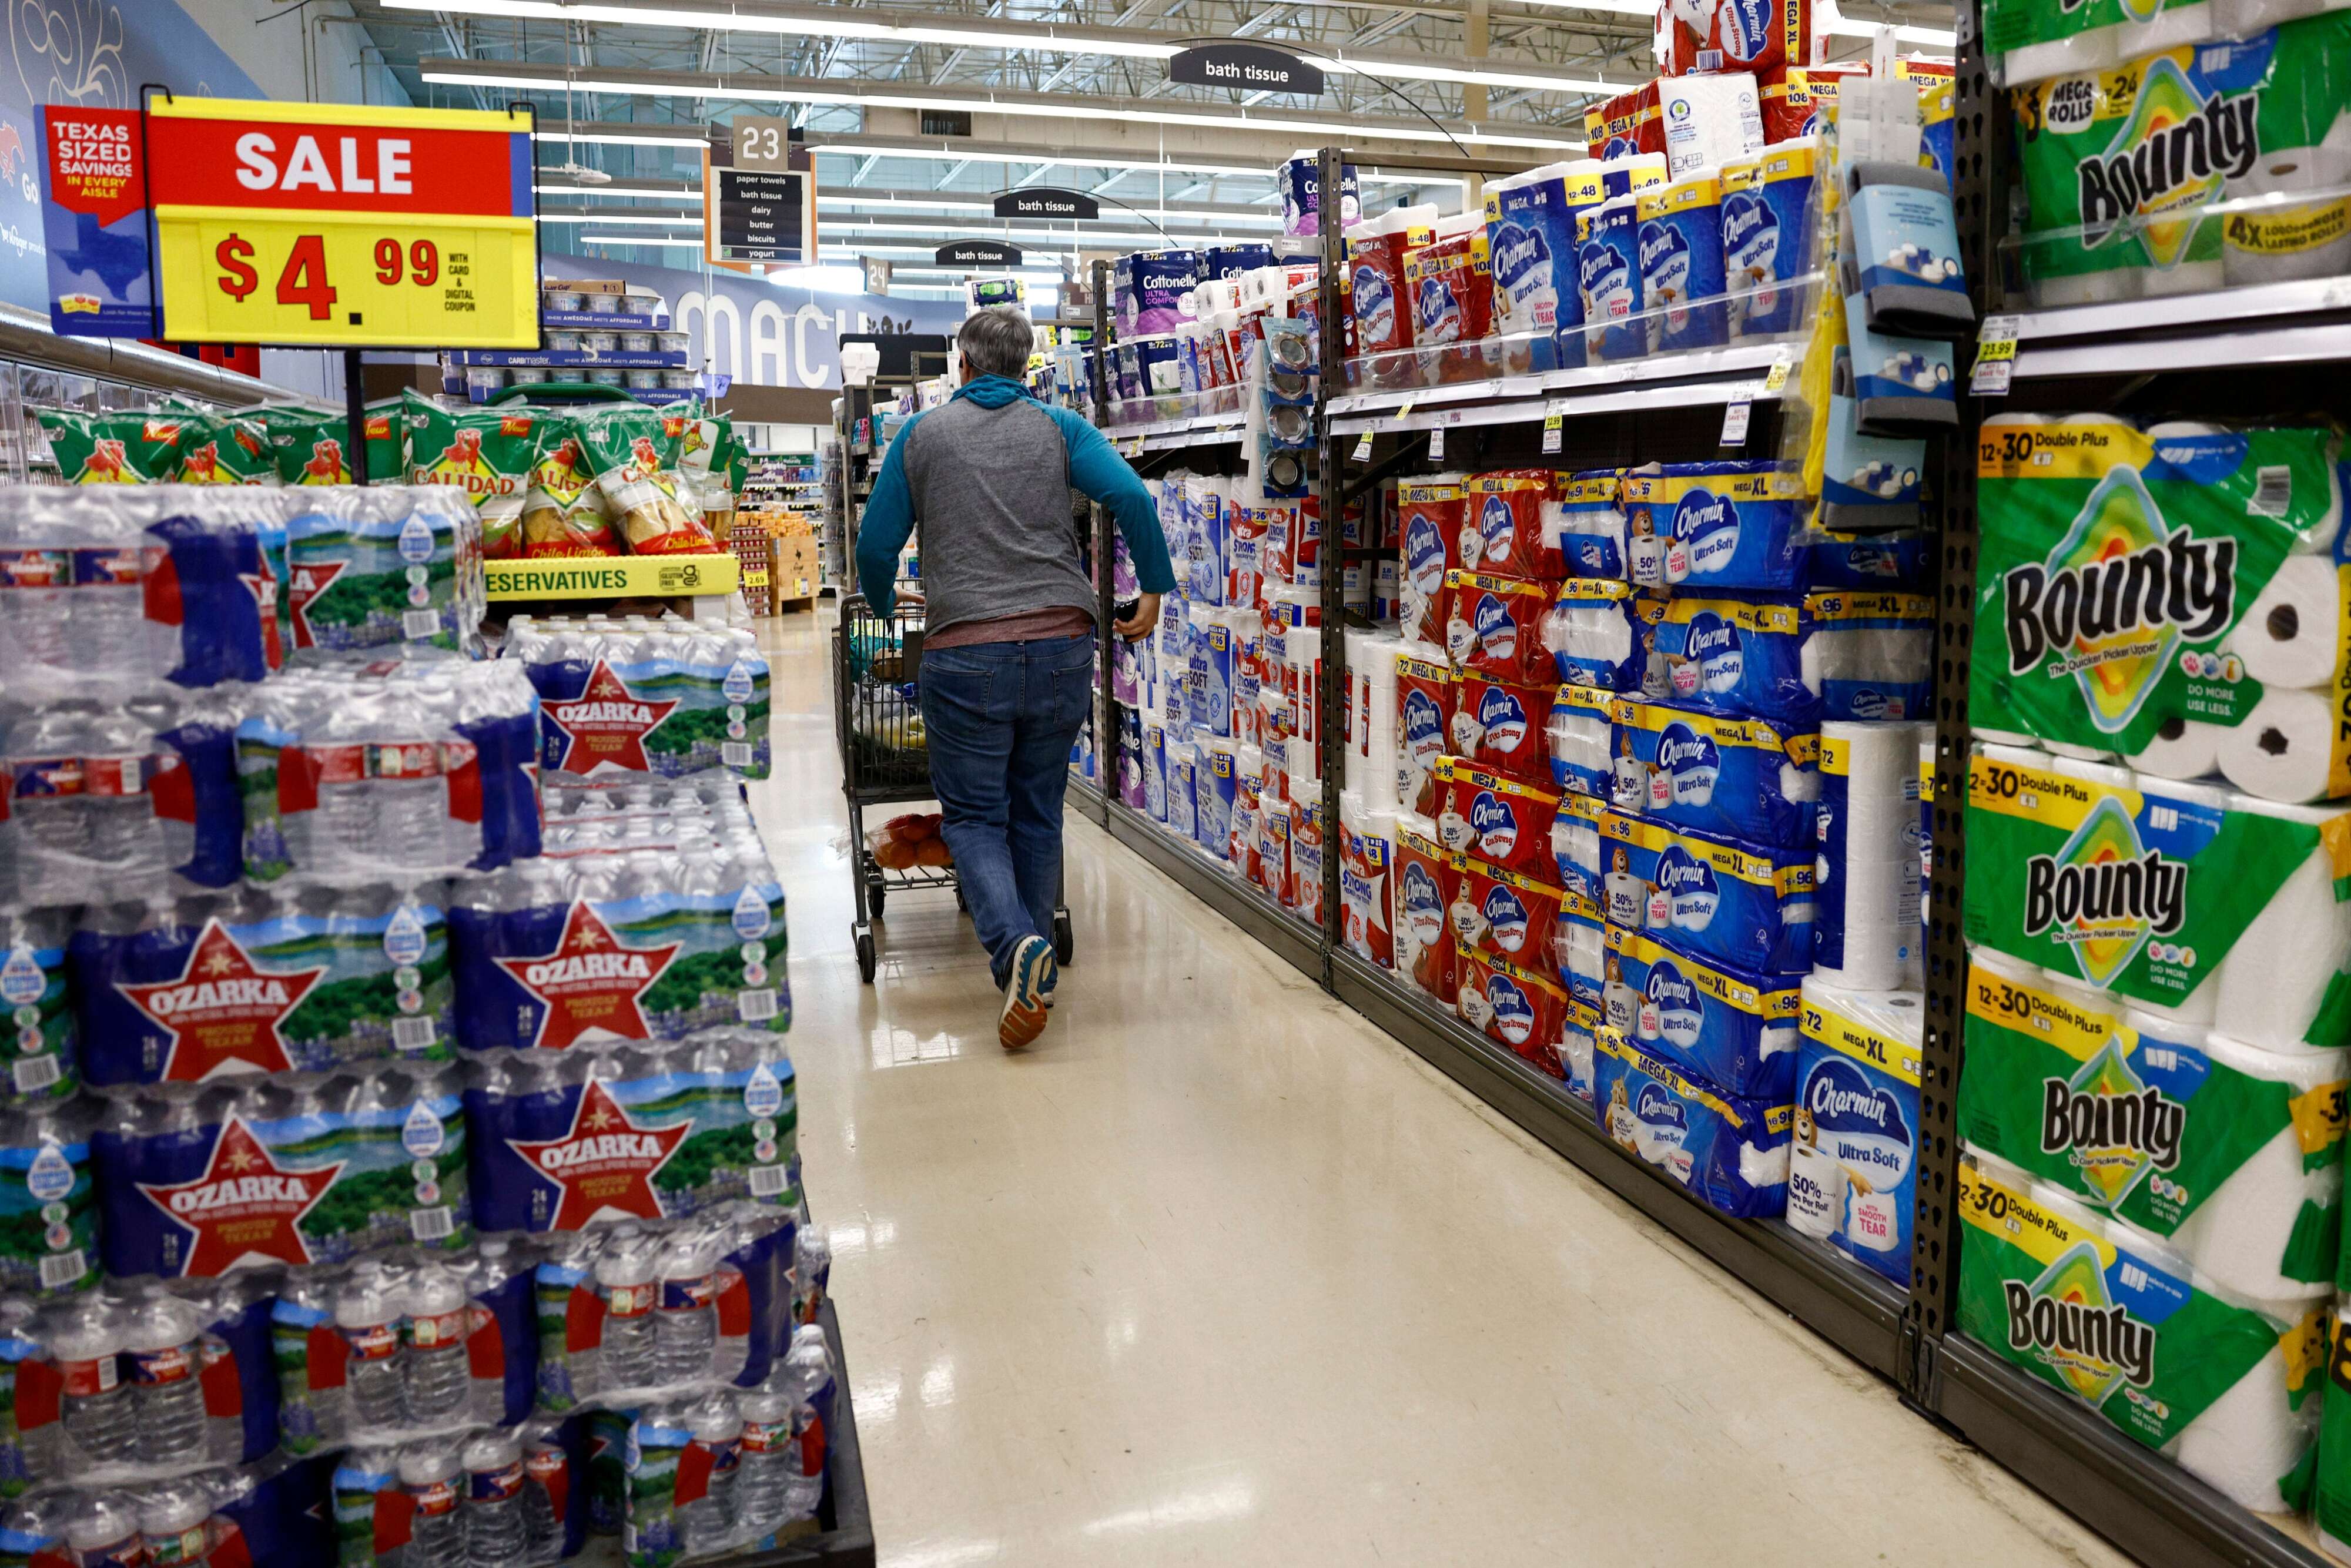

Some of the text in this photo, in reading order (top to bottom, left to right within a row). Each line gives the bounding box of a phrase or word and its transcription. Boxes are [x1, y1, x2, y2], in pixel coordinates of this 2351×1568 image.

[1205, 61, 1289, 82] bath tissue
[1788, 92, 1808, 103] 108
[1810, 85, 1837, 96] MEGA
[2052, 80, 2092, 103] MEGA
[2049, 100, 2093, 122] ROLLS
[52, 122, 129, 142] TEXAS
[58, 140, 131, 162] SIZED
[743, 126, 779, 160] 23
[60, 160, 132, 177] SAVINGS
[236, 132, 413, 195] SALE
[2081, 95, 2256, 247] Bounty
[68, 176, 127, 187] IN EVERY
[760, 176, 786, 185] towels
[81, 188, 118, 198] AISLE
[761, 192, 782, 200] tissue
[751, 206, 771, 215] dairy
[1018, 200, 1075, 212] bath tissue
[749, 220, 773, 229] butter
[1723, 205, 1763, 246] Charmin
[747, 234, 775, 243] biscuits
[448, 253, 468, 263] WITH
[749, 250, 775, 258] yogurt
[955, 251, 1003, 261] bath tissue
[1495, 236, 1538, 281] Charmin
[1639, 230, 1674, 270] Charmin
[448, 266, 469, 276] CARD
[1422, 260, 1441, 274] MEGA
[1581, 249, 1612, 286] Charmin
[456, 277, 462, 287] &
[869, 266, 885, 287] 24
[1143, 273, 1197, 290] Cottonelle
[445, 290, 474, 300] DIGITAL
[1515, 282, 1532, 304] Ultra
[444, 301, 475, 311] COUPON
[1534, 301, 1555, 311] SMOOTH
[1610, 306, 1627, 317] TEAR
[1535, 311, 1555, 324] TEAR
[1547, 416, 1560, 426] 22.99
[2035, 432, 2077, 447] Double
[2081, 431, 2108, 447] Plus
[414, 470, 514, 494] CALIDAD
[1752, 478, 1768, 496] XL
[1676, 500, 1724, 538] Charmin
[1407, 530, 1435, 561] Charmin
[1694, 537, 1734, 562] Ultra Soft
[1670, 562, 1686, 574] TEAR
[1878, 597, 1901, 613] XL
[2008, 529, 2234, 671] Bounty
[1164, 605, 1178, 617] ultra
[1478, 604, 1504, 631] Charmin
[1163, 618, 1179, 631] SOFT
[1268, 623, 1280, 634] ultra
[1265, 636, 1285, 651] STRONG
[1189, 656, 1207, 670] ultra
[2068, 642, 2159, 671] Quicker Picker Upper
[1189, 672, 1208, 688] SOFT
[2188, 684, 2236, 701] DO MORE.
[556, 702, 653, 723] OZARKA
[1166, 707, 1181, 721] SOFT
[2188, 700, 2232, 716] USE LESS.
[1406, 705, 1436, 732] Charmin
[1716, 727, 1739, 738] MEGA
[548, 736, 560, 747] 24
[1264, 741, 1285, 757] STRONG
[1660, 733, 1706, 766] Charmin
[1677, 778, 1696, 793] Ultra
[2021, 773, 2088, 802] Double Plus
[1298, 826, 1315, 843] ultra
[1294, 840, 1321, 861] STRONG
[1368, 848, 1378, 859] 48
[1712, 853, 1744, 874] MEGA XL
[1661, 859, 1706, 888] Charmin
[1342, 870, 1372, 900] STRONG
[1405, 876, 1434, 903] Charmin
[2027, 853, 2186, 934] Bounty
[1486, 897, 1518, 917] Charmin
[1615, 893, 1633, 906] 50%
[1677, 902, 1712, 915] Ultra Soft
[2094, 930, 2115, 939] Picker
[527, 954, 649, 985] OZARKA
[1649, 973, 1691, 1004] Charmin
[1697, 973, 1729, 999] MEGA XL
[149, 979, 290, 1016] OZARKA
[1489, 990, 1520, 1009] Charmin
[1663, 1018, 1682, 1030] Ultra
[2032, 997, 2073, 1024] Double
[2074, 1016, 2103, 1035] Plus
[1843, 1031, 1887, 1064] MEGA XL
[1638, 1054, 1679, 1090] MEGA XL
[1641, 1094, 1679, 1120] Charmin
[1812, 1077, 1887, 1127] Charmin
[540, 1133, 662, 1170] OZARKA
[1838, 1141, 1900, 1171] Ultra Soft
[1676, 1163, 1689, 1174] Tear
[170, 1176, 310, 1214] OZARKA
[1793, 1173, 1821, 1200] 50%
[1803, 1195, 1829, 1212] Per Roll
[1866, 1204, 1878, 1212] WITH
[1858, 1208, 1887, 1222] SMOOTH
[2008, 1198, 2069, 1242] Double Plus
[1860, 1219, 1887, 1237] TEAR
[2005, 1282, 2152, 1384] Bounty
